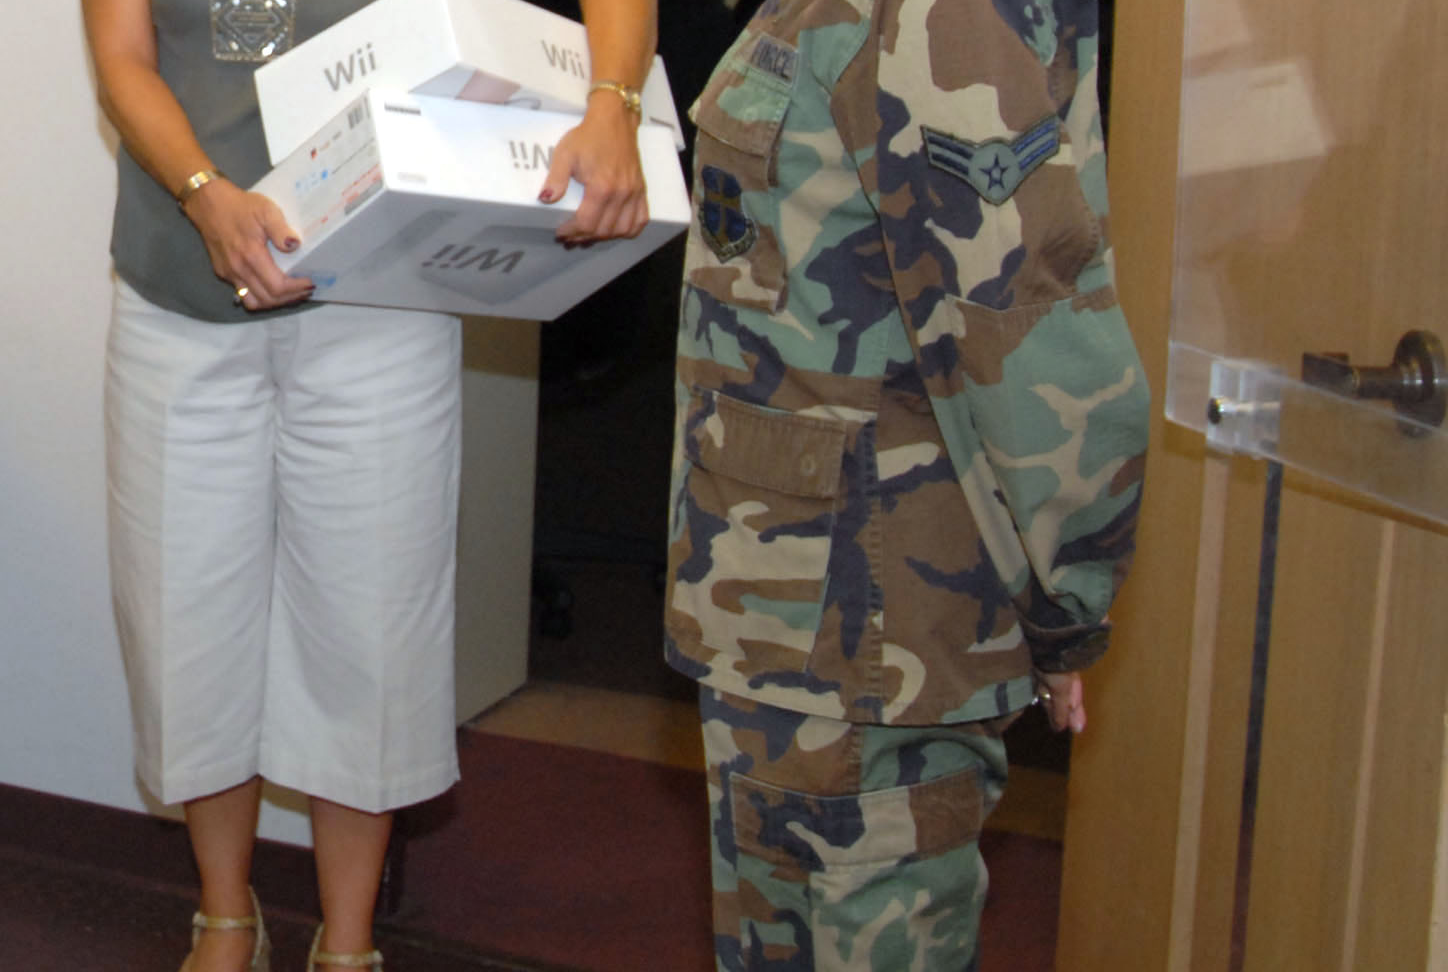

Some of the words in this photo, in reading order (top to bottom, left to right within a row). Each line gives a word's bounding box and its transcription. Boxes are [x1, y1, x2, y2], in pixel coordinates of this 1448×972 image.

[323, 41, 378, 93] Wii
[540, 38, 585, 80] Wii
[420, 243, 526, 274] Wii
